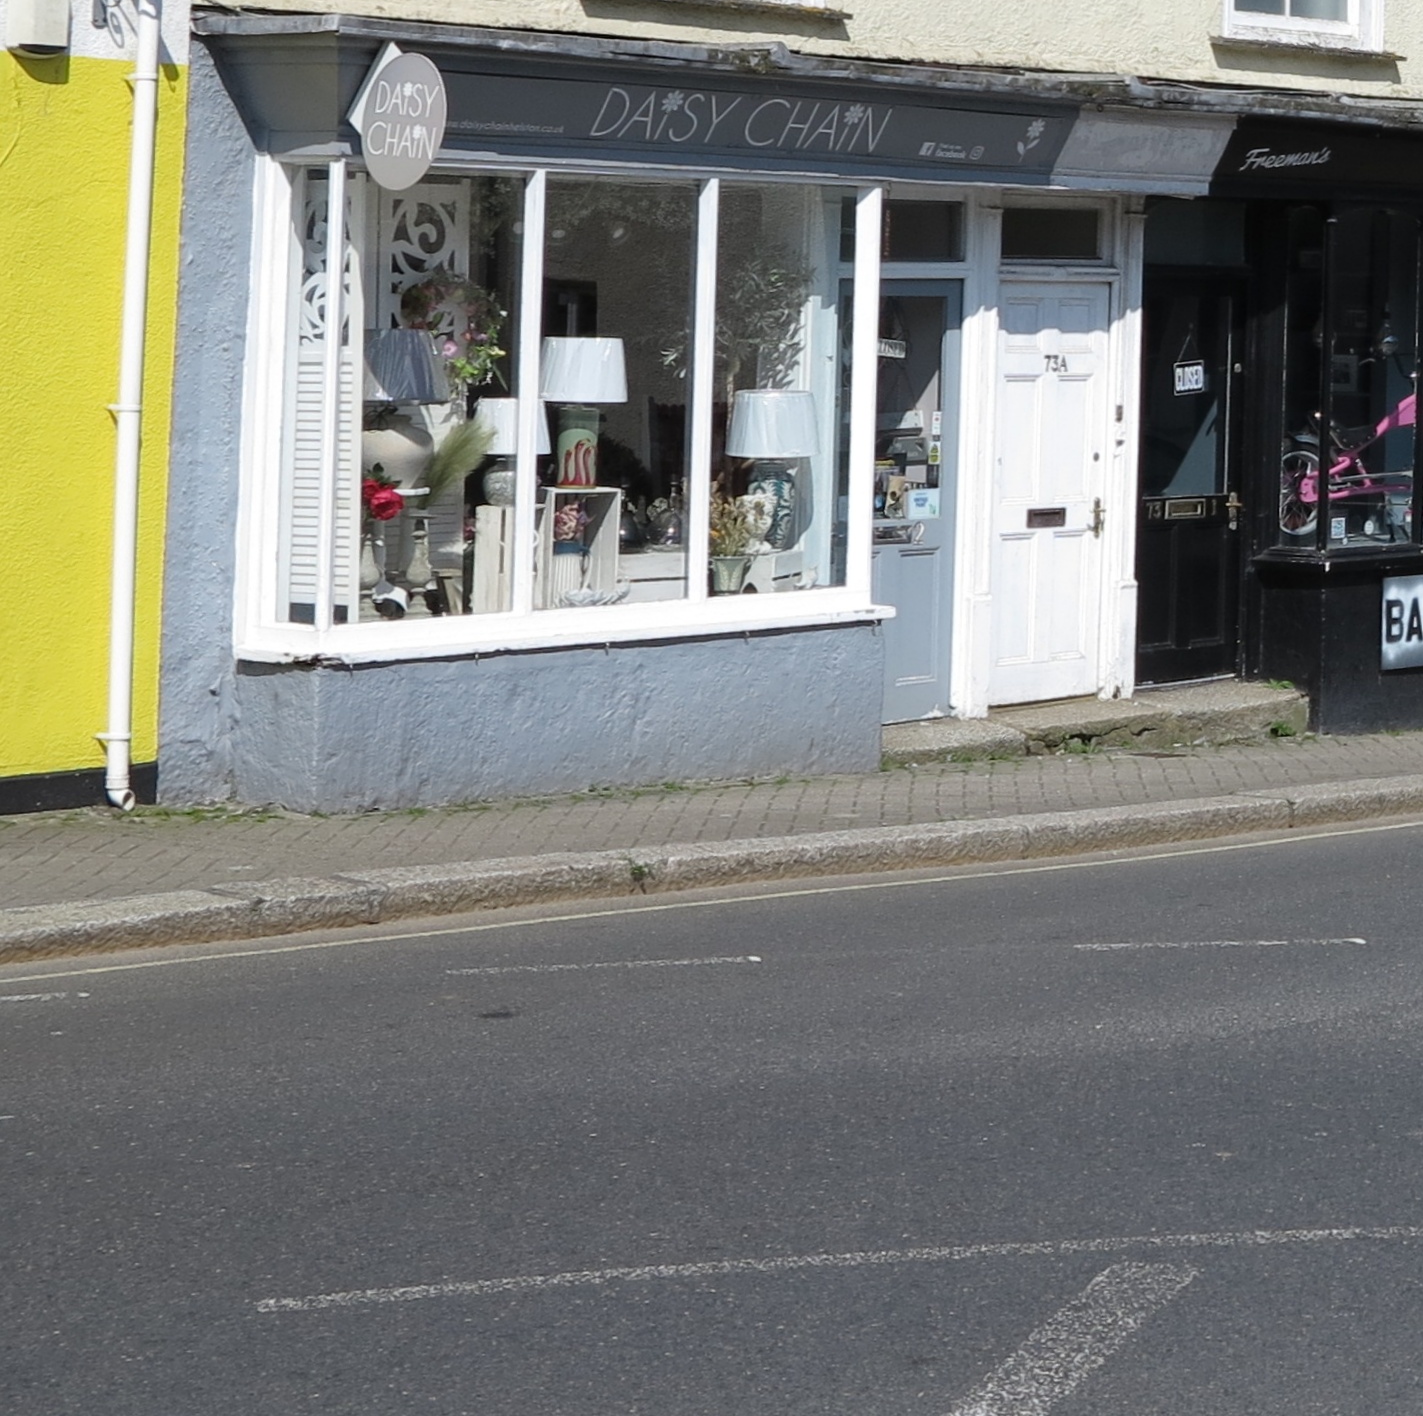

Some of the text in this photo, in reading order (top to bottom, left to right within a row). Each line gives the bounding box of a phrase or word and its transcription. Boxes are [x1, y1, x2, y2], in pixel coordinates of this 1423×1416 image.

[374, 80, 440, 118] DAISY
[590, 87, 894, 153] DAISY CHAIN
[367, 121, 437, 160] CHAIN
[1238, 147, 1332, 172] Freeman's
[1044, 355, 1068, 373] 73A
[1175, 365, 1203, 392] CLOSED
